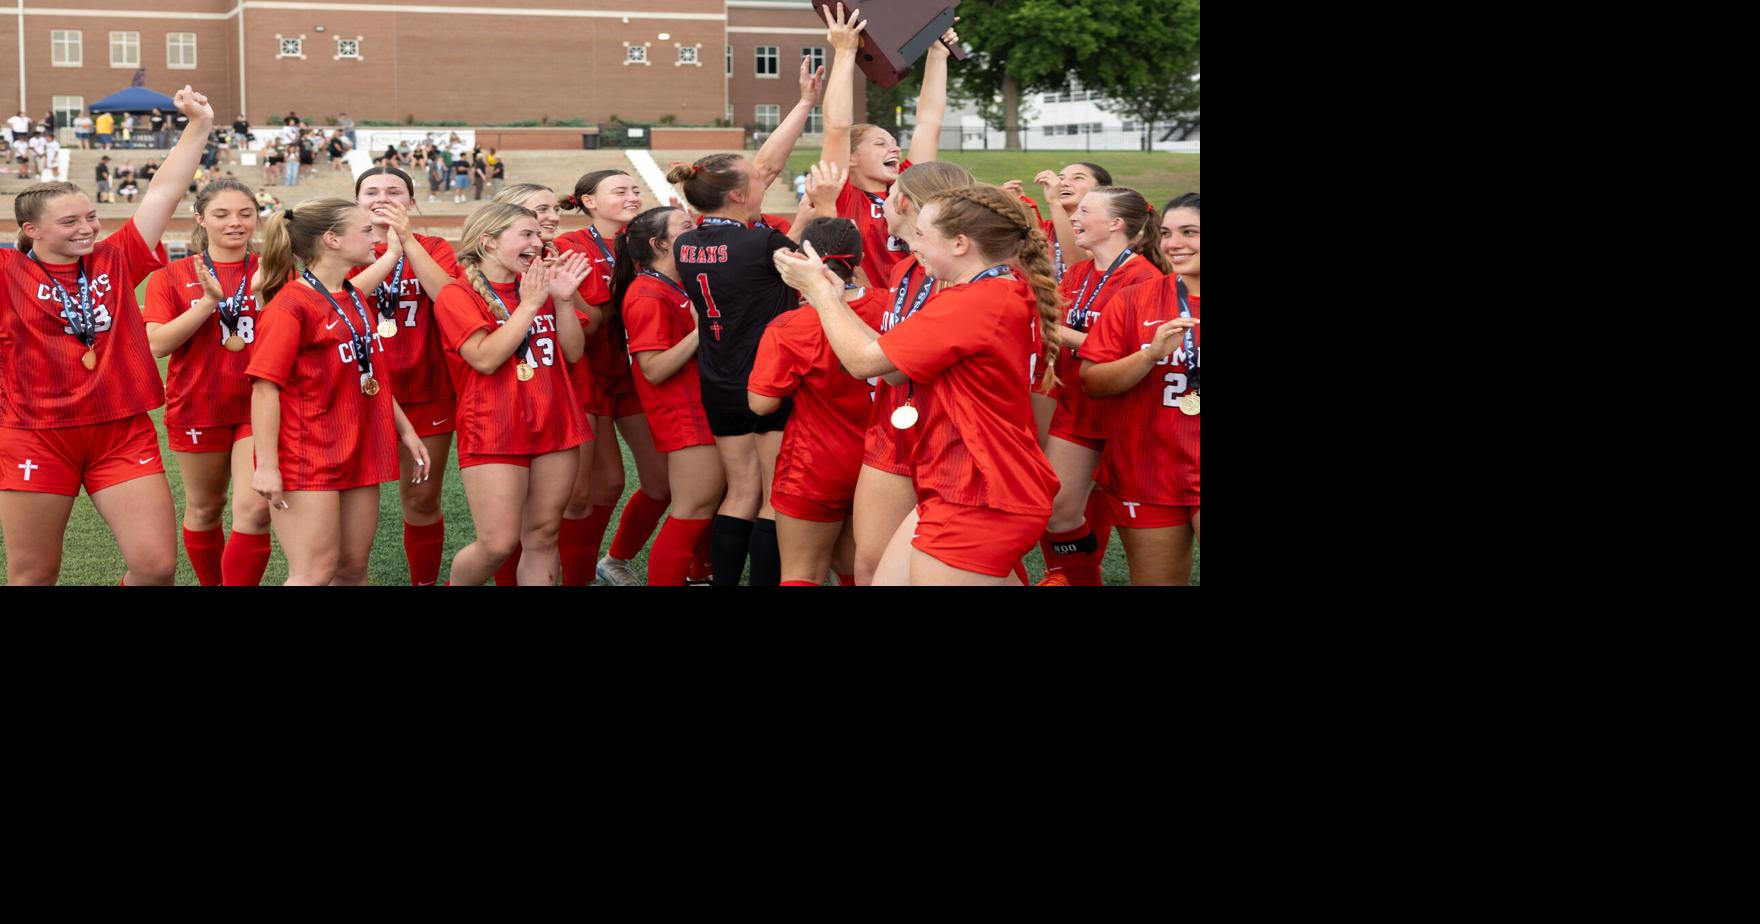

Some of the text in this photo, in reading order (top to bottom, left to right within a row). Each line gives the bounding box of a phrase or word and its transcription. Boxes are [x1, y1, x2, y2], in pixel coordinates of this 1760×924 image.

[680, 245, 728, 264] MEANS
[696, 273, 721, 318] 1
[219, 315, 255, 346] 18
[524, 337, 555, 369] 13
